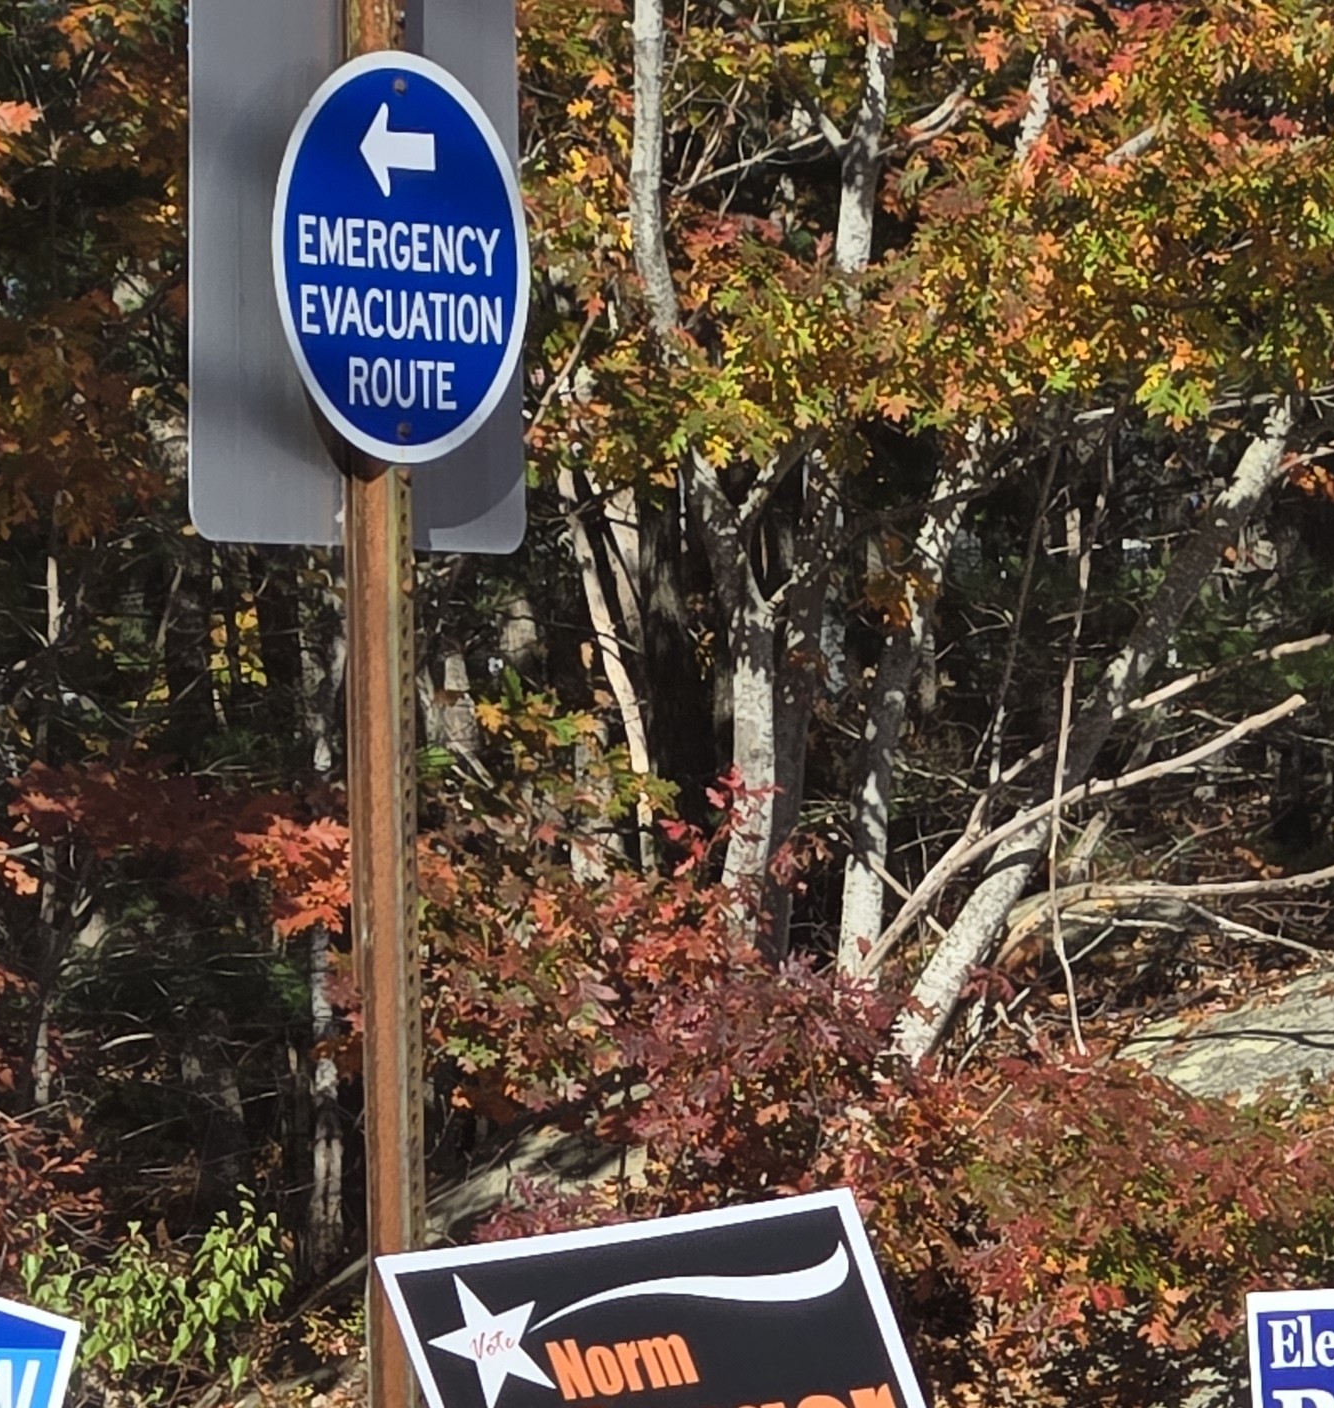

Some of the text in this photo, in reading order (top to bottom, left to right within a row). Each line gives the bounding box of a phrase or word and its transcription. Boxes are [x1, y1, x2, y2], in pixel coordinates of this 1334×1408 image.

[298, 213, 501, 277] EMERGENCY
[300, 283, 503, 345] EVACUATION
[348, 356, 457, 411] ROUTE
[470, 1331, 515, 1359] Vote
[545, 1333, 699, 1401] Norm
